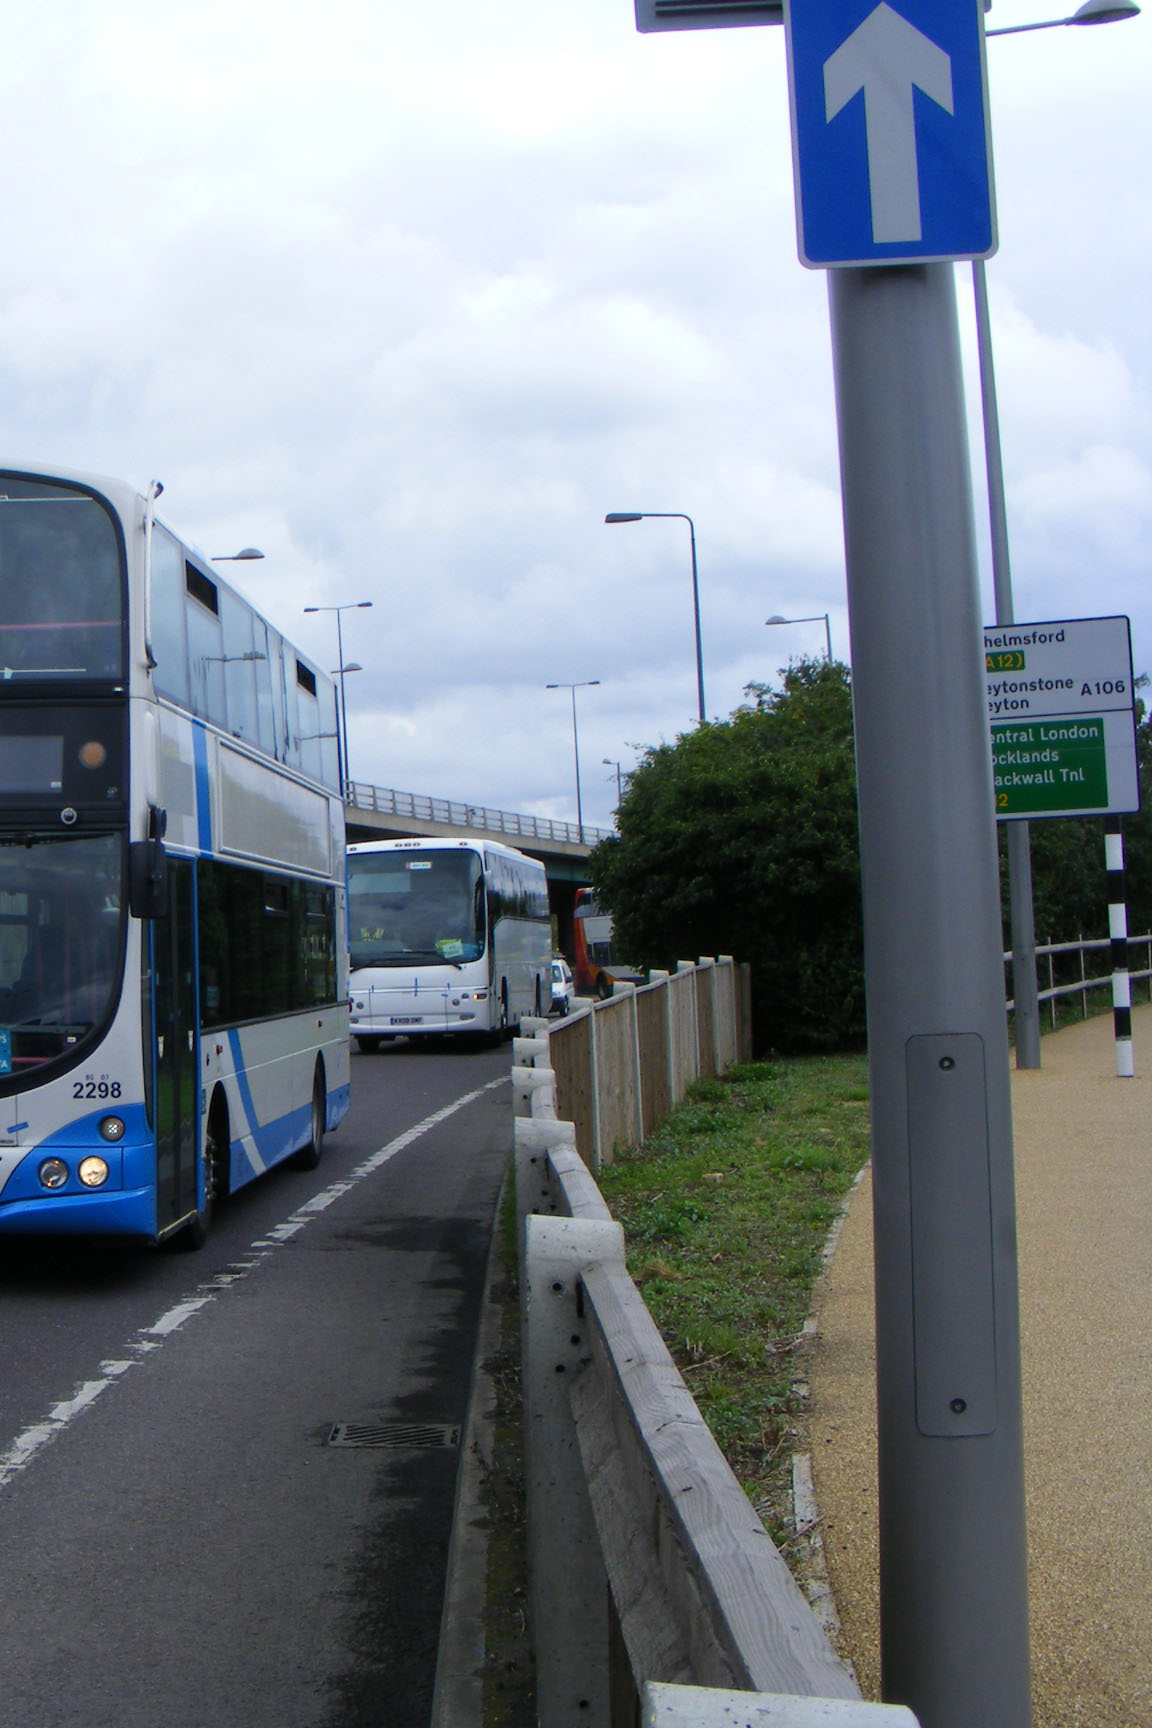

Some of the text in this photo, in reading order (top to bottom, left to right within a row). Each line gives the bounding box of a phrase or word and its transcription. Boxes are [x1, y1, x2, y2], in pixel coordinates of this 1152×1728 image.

[984, 630, 1065, 648] helmsford
[986, 652, 1023, 669] A12)
[988, 678, 1074, 697] eytonstone
[1081, 680, 1125, 696] A106
[989, 698, 1030, 714] eyton
[991, 725, 1098, 743] entral London
[992, 748, 1060, 765] ocklands
[994, 766, 1085, 786] ackwall Tnl
[72, 1081, 122, 1099] 2298
